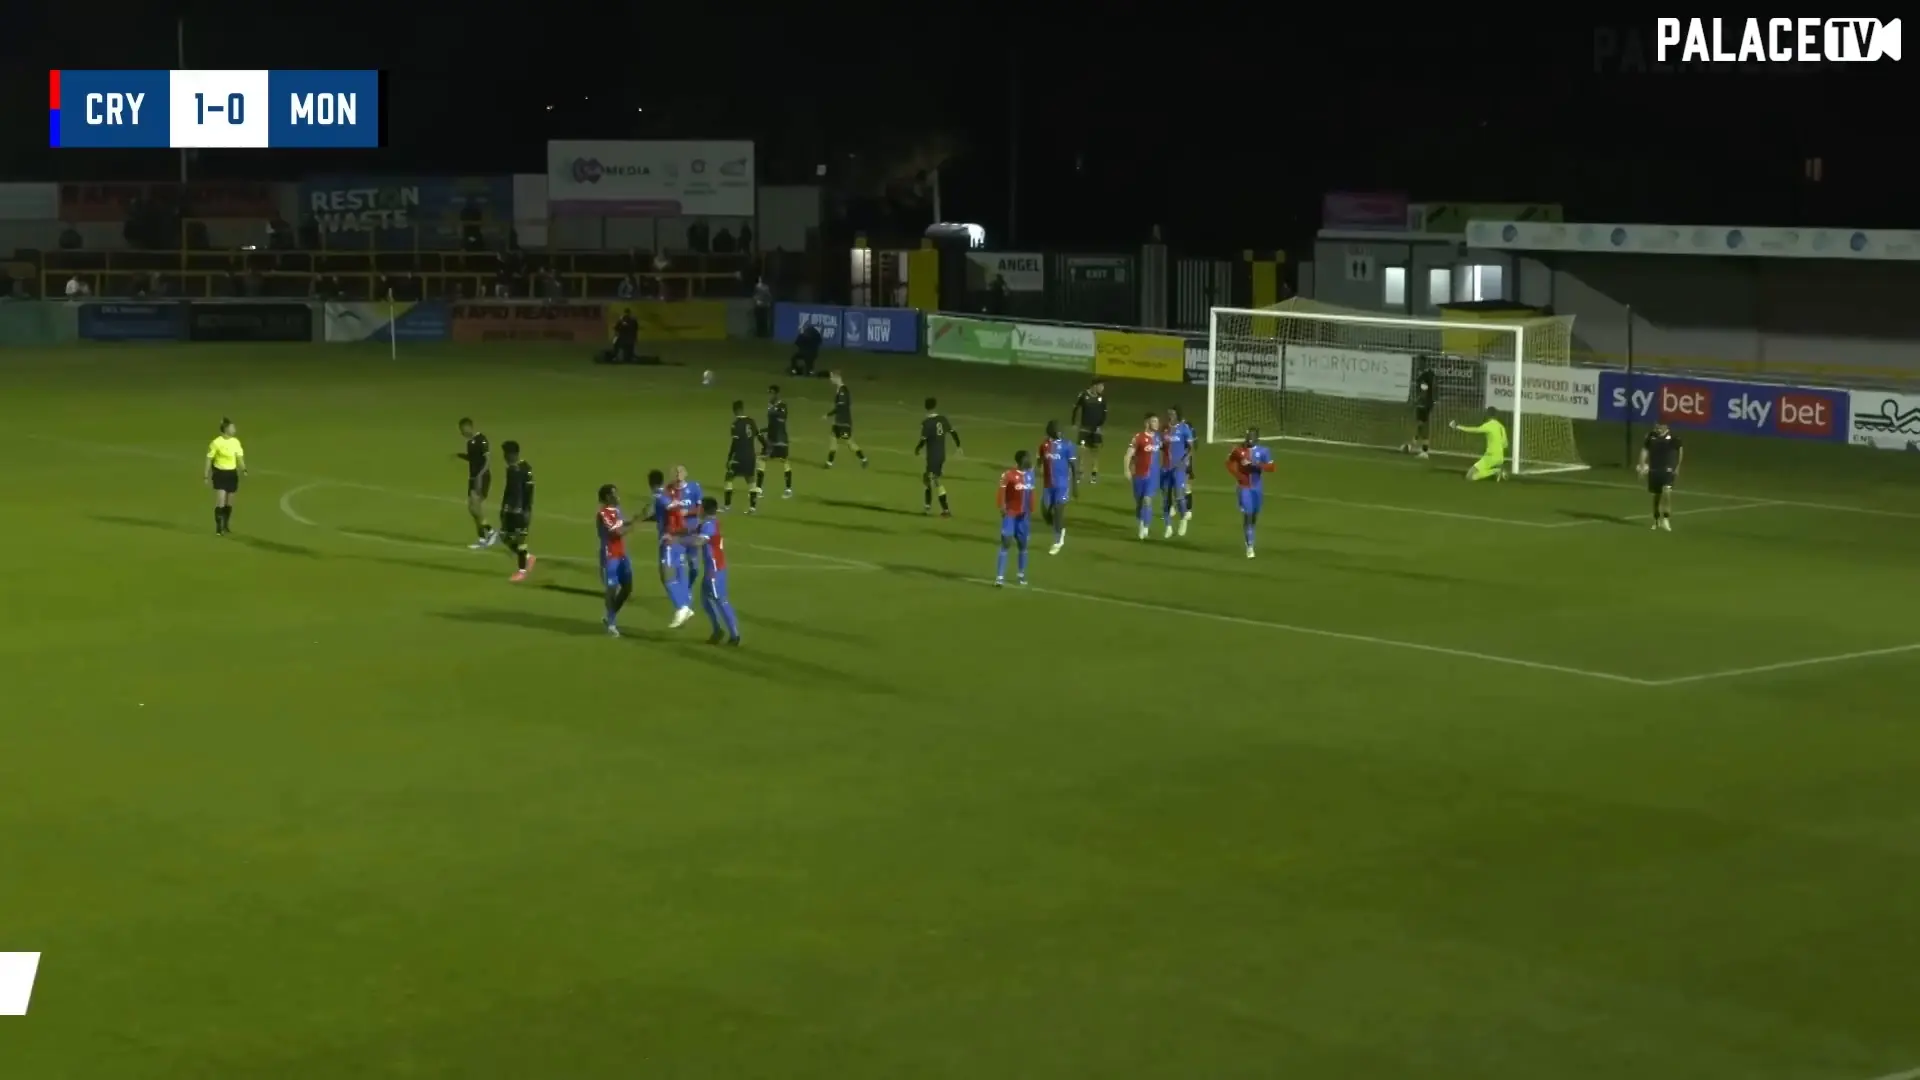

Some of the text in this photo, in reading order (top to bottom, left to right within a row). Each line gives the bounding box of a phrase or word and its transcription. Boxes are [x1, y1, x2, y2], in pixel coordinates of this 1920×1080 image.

[310, 185, 420, 212] RESTON
[313, 208, 409, 233] WASTE
[998, 258, 1041, 272] ANGEL
[1084, 268, 1108, 279] EXIT
[867, 324, 892, 343] NOW
[1301, 353, 1390, 375] THORNTONS
[1489, 373, 1569, 392] SOUHWOOD
[1494, 387, 1533, 401] ROOING
[1662, 386, 1705, 416] bet
[1727, 392, 1827, 428] sky bet
[935, 421, 944, 436] 8
